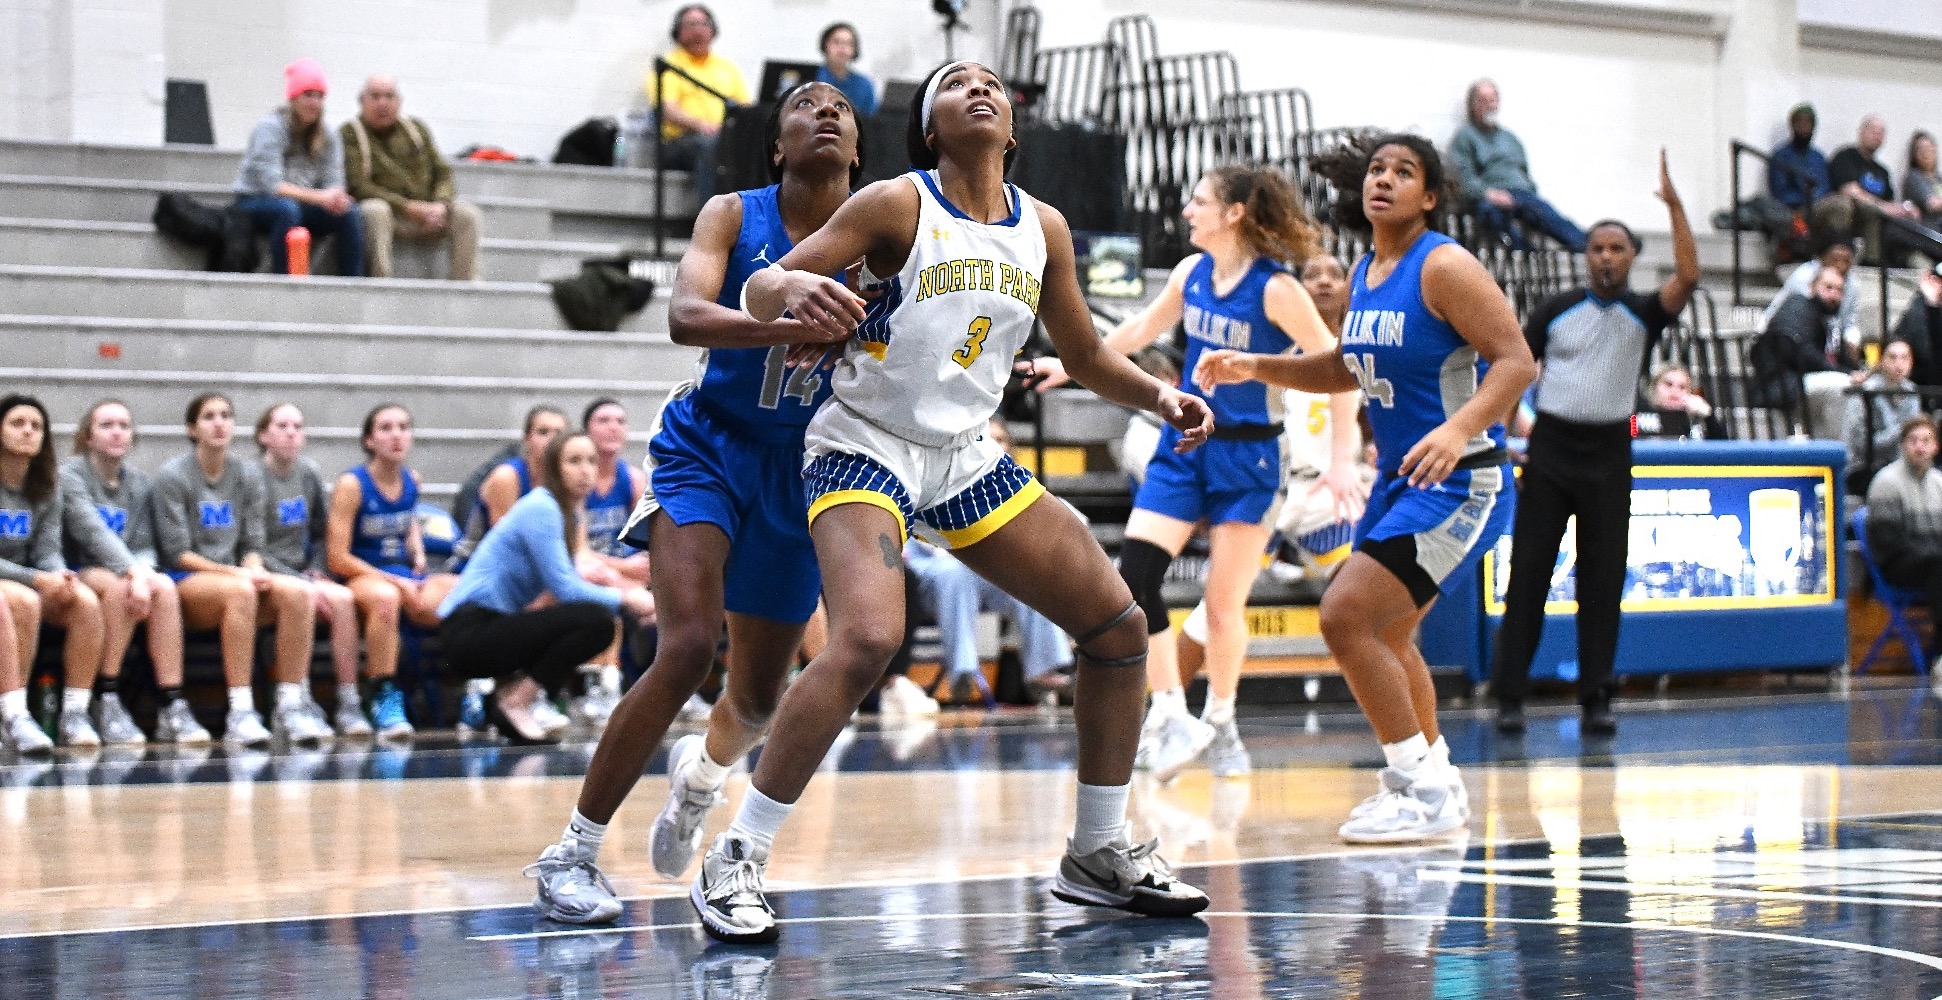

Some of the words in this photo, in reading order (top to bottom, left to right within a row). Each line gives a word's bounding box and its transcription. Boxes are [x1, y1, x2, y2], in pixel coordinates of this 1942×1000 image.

[915, 259, 994, 303] NORTH
[952, 316, 992, 369] 3
[758, 343, 825, 410] 14
[1306, 400, 1329, 436] 5
[0, 509, 31, 537] M
[199, 500, 232, 527] M
